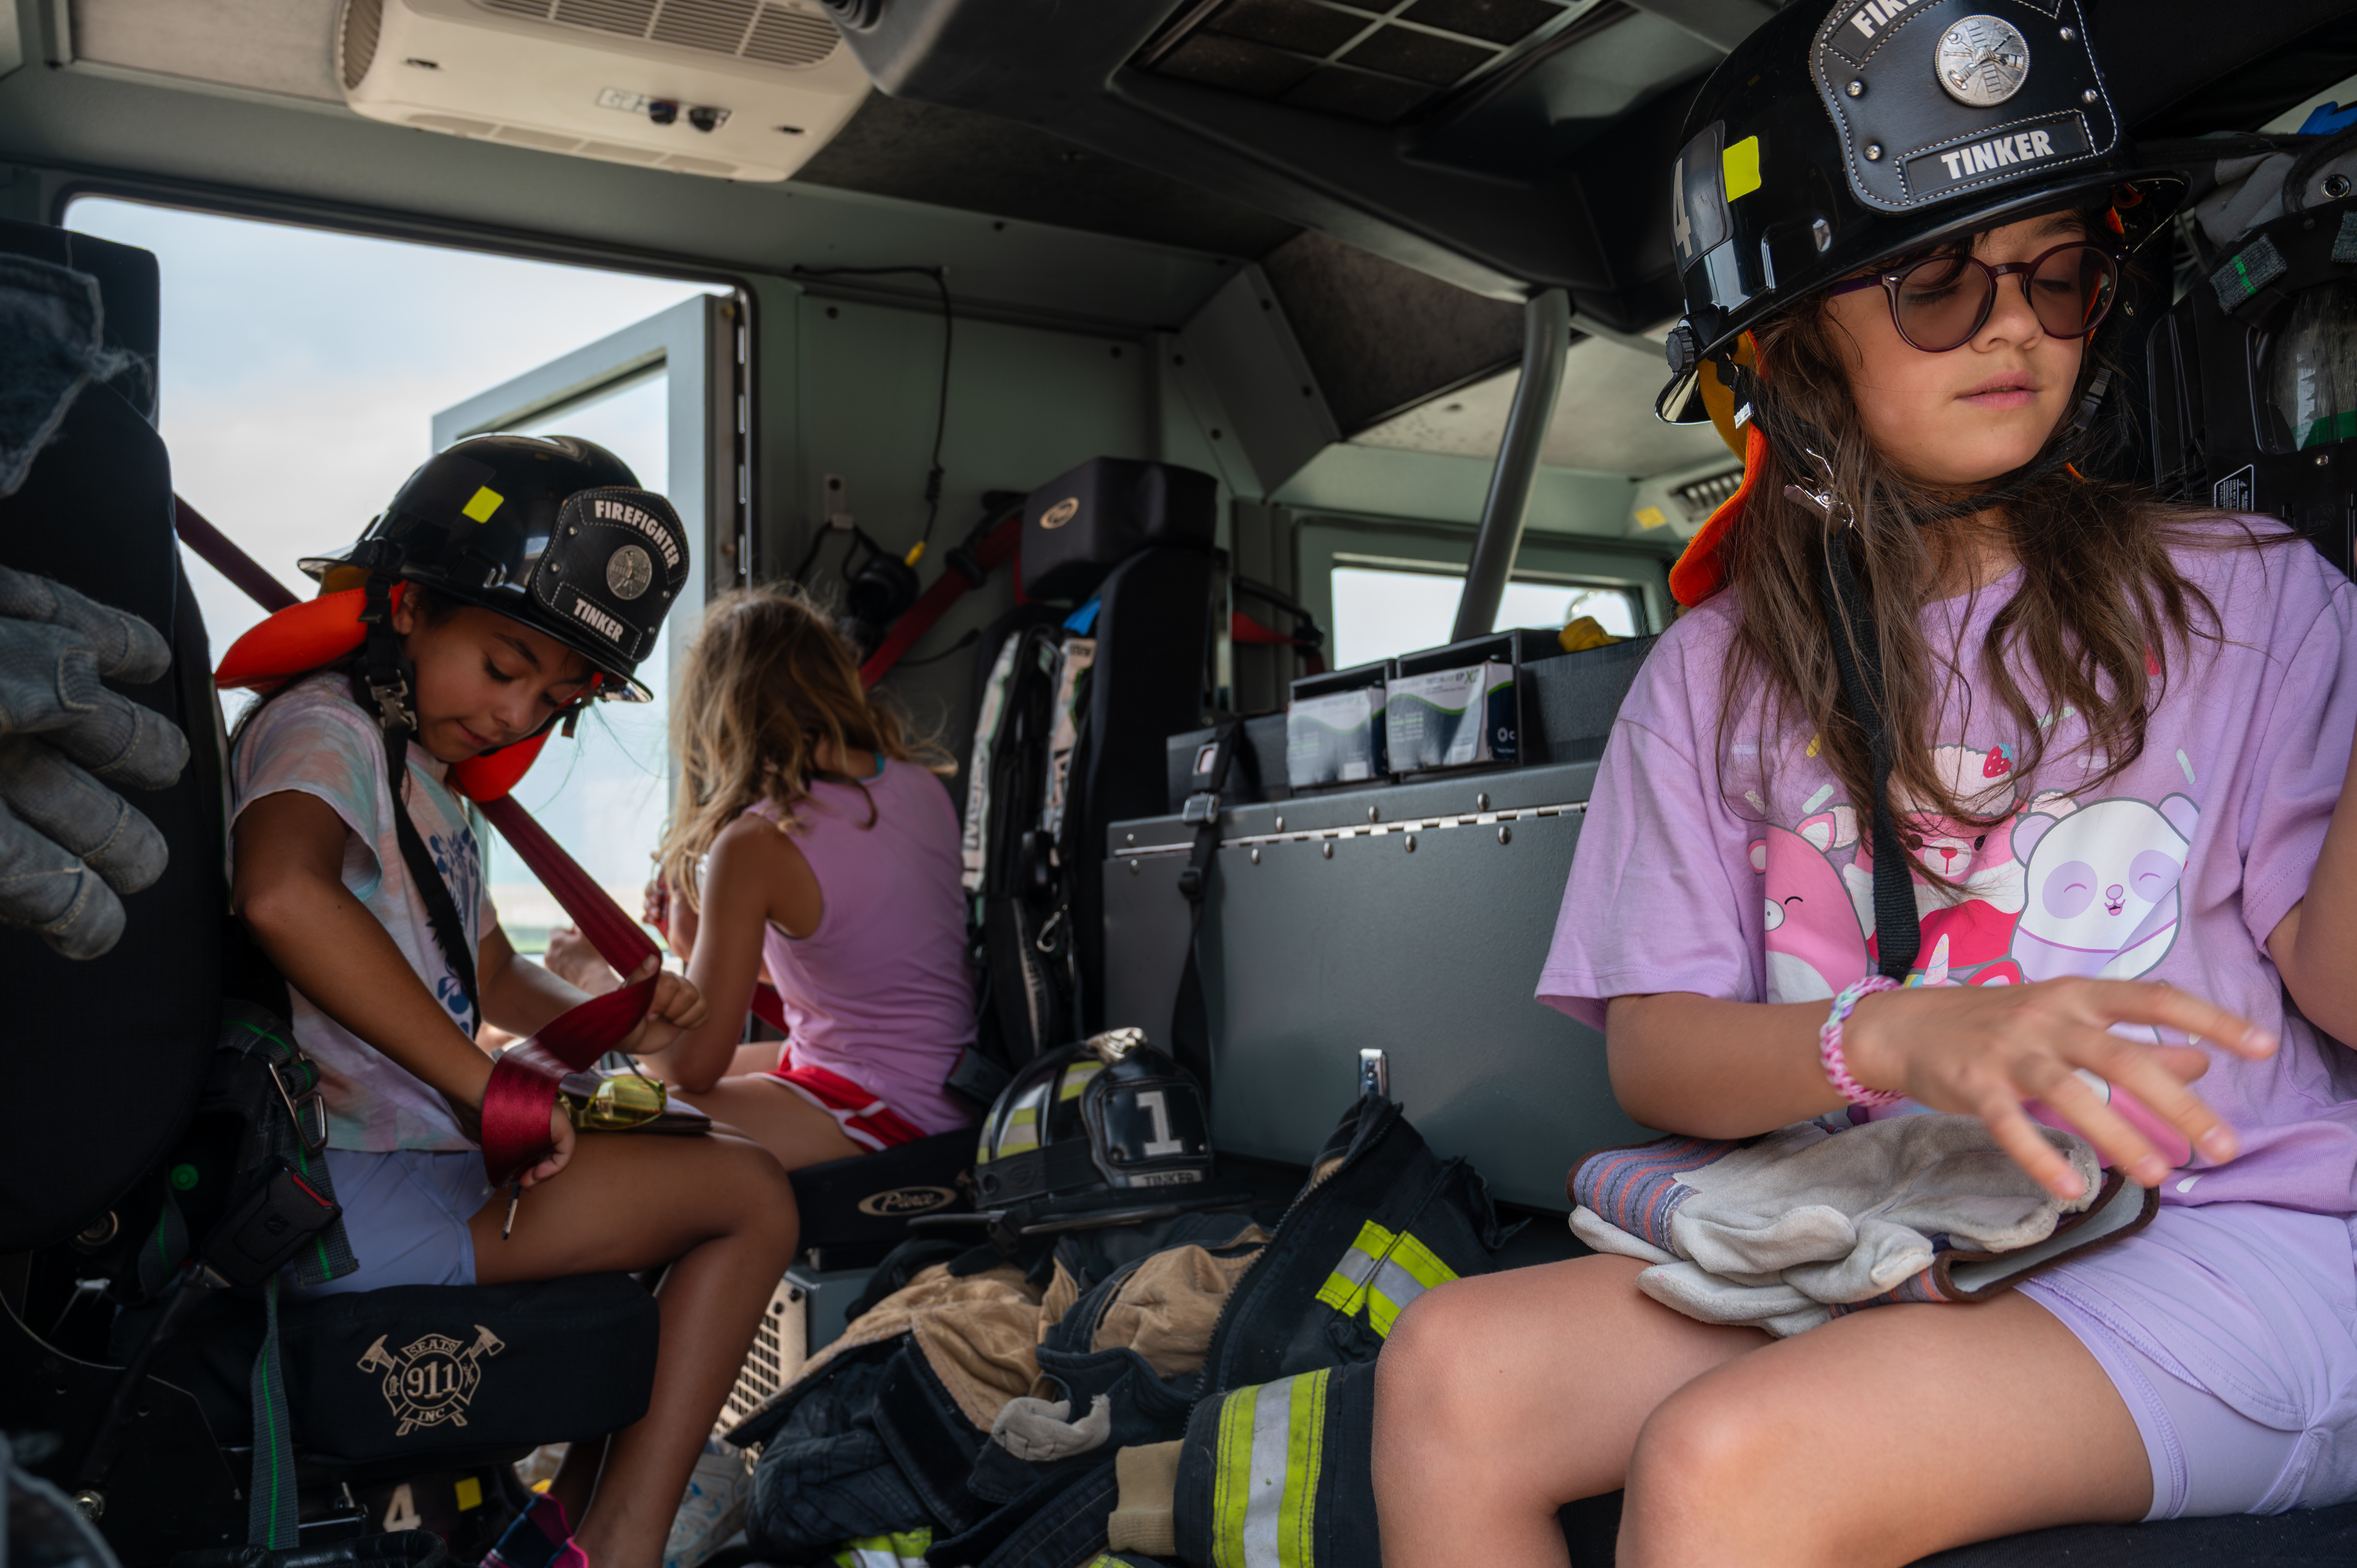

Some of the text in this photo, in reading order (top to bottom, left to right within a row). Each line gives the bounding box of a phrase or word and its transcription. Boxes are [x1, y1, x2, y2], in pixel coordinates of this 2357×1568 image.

[1941, 130, 2054, 179] TINKER
[1673, 158, 1692, 259] 4
[595, 500, 680, 569] FIREFIGHTER
[573, 598, 623, 642] TINKER
[1136, 1090, 1184, 1156] 1
[408, 1339, 456, 1356] SEATS
[407, 1361, 457, 1399] 911
[417, 1408, 445, 1421] INC
[382, 1482, 422, 1533] 4
